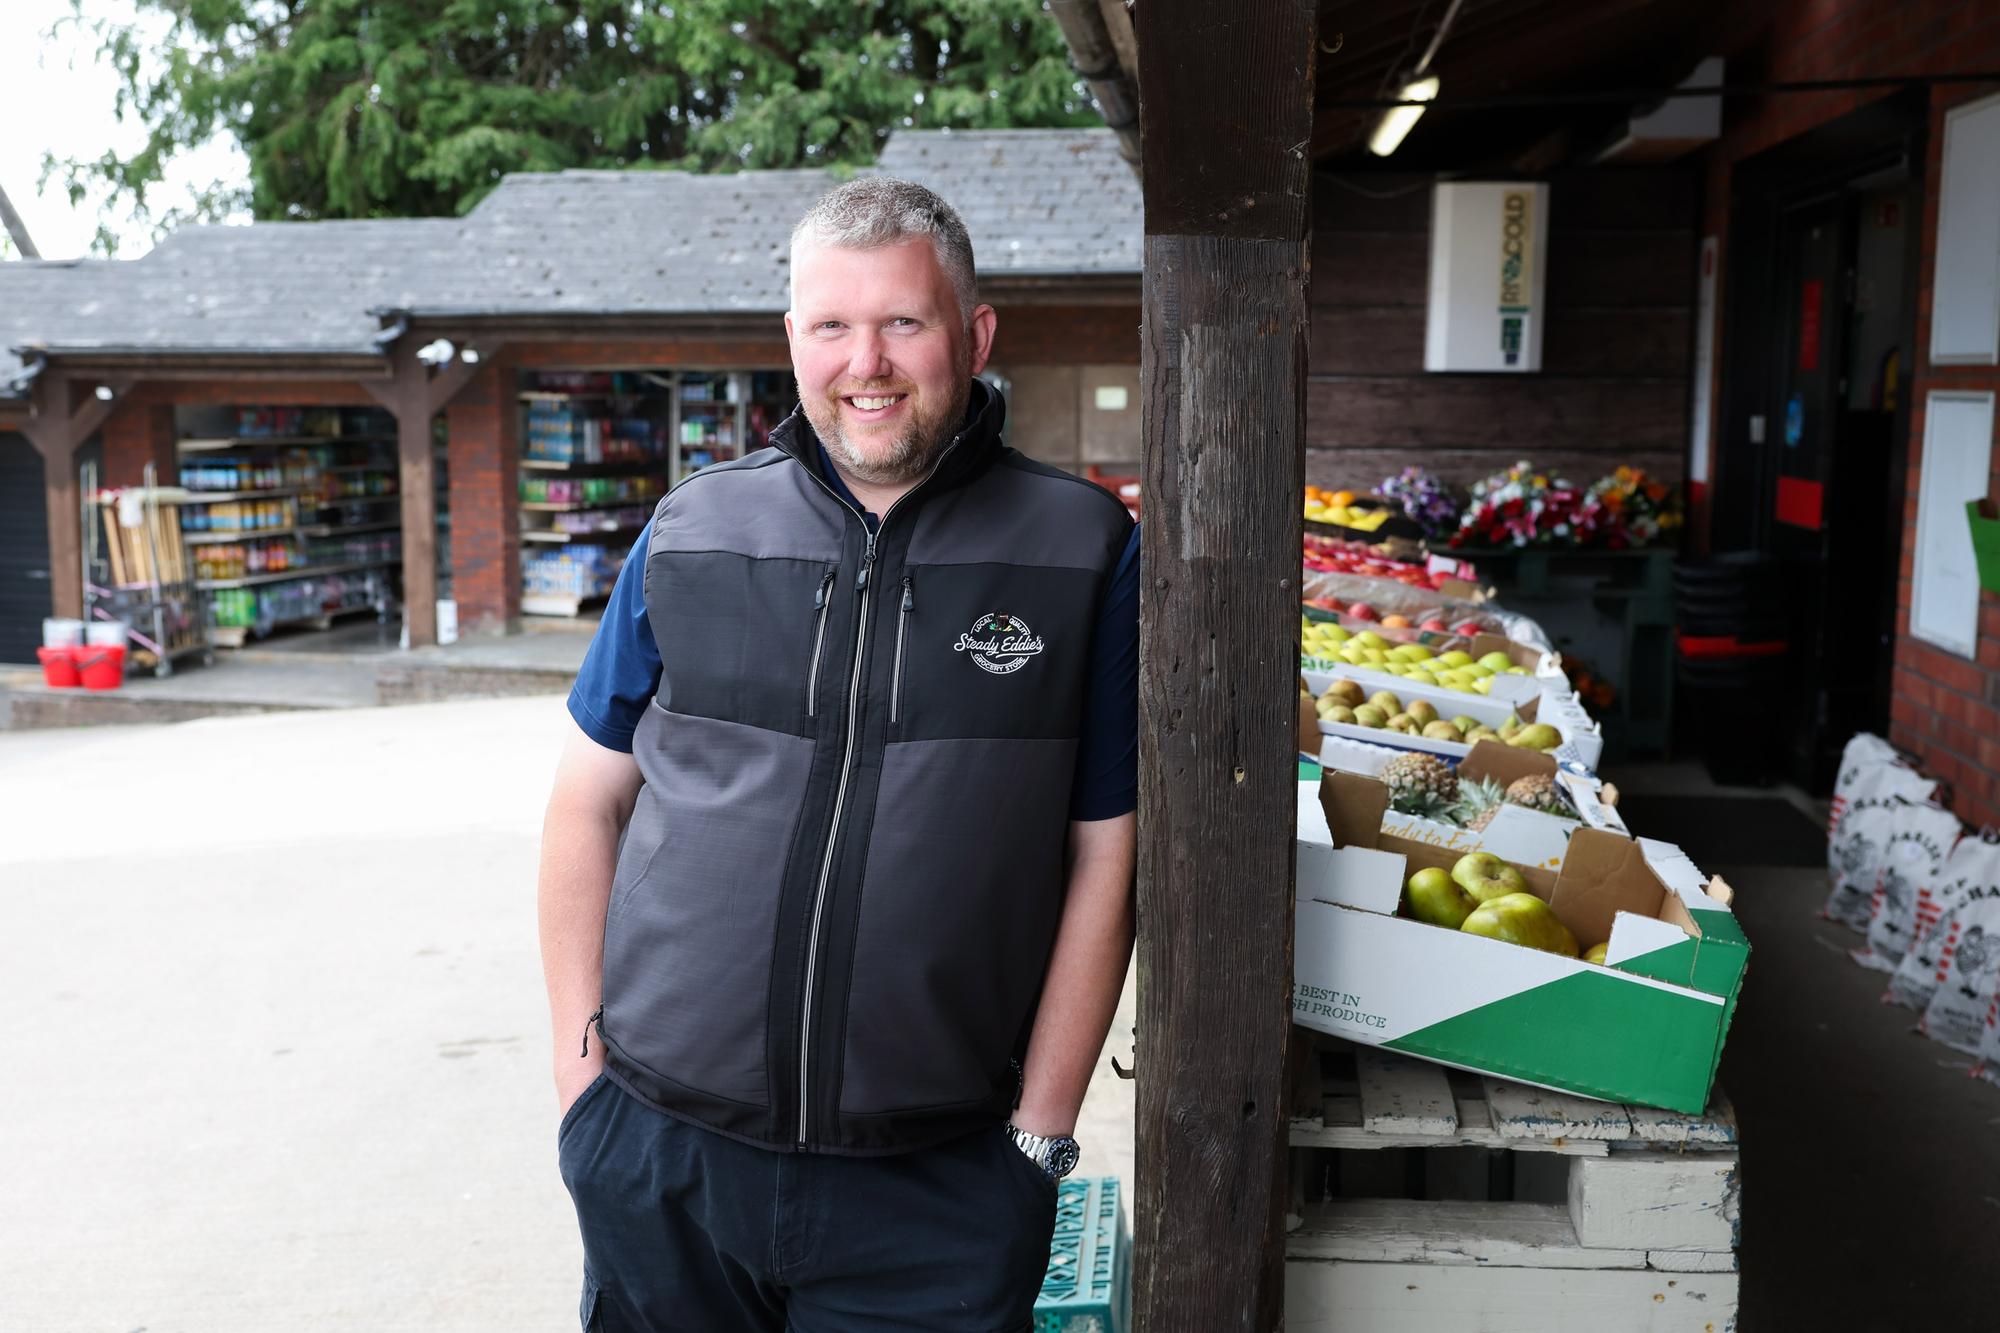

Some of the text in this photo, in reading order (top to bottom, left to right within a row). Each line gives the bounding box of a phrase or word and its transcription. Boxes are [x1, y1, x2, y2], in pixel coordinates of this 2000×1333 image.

[974, 616, 1029, 636] LOCAL QUALITY
[953, 632, 1045, 657] Steady Eddie's
[974, 653, 1026, 672] GROCERY STORE
[1300, 984, 1339, 1003] BEST
[1341, 993, 1361, 1008] IN
[1311, 1002, 1387, 1029] PRODUCE
